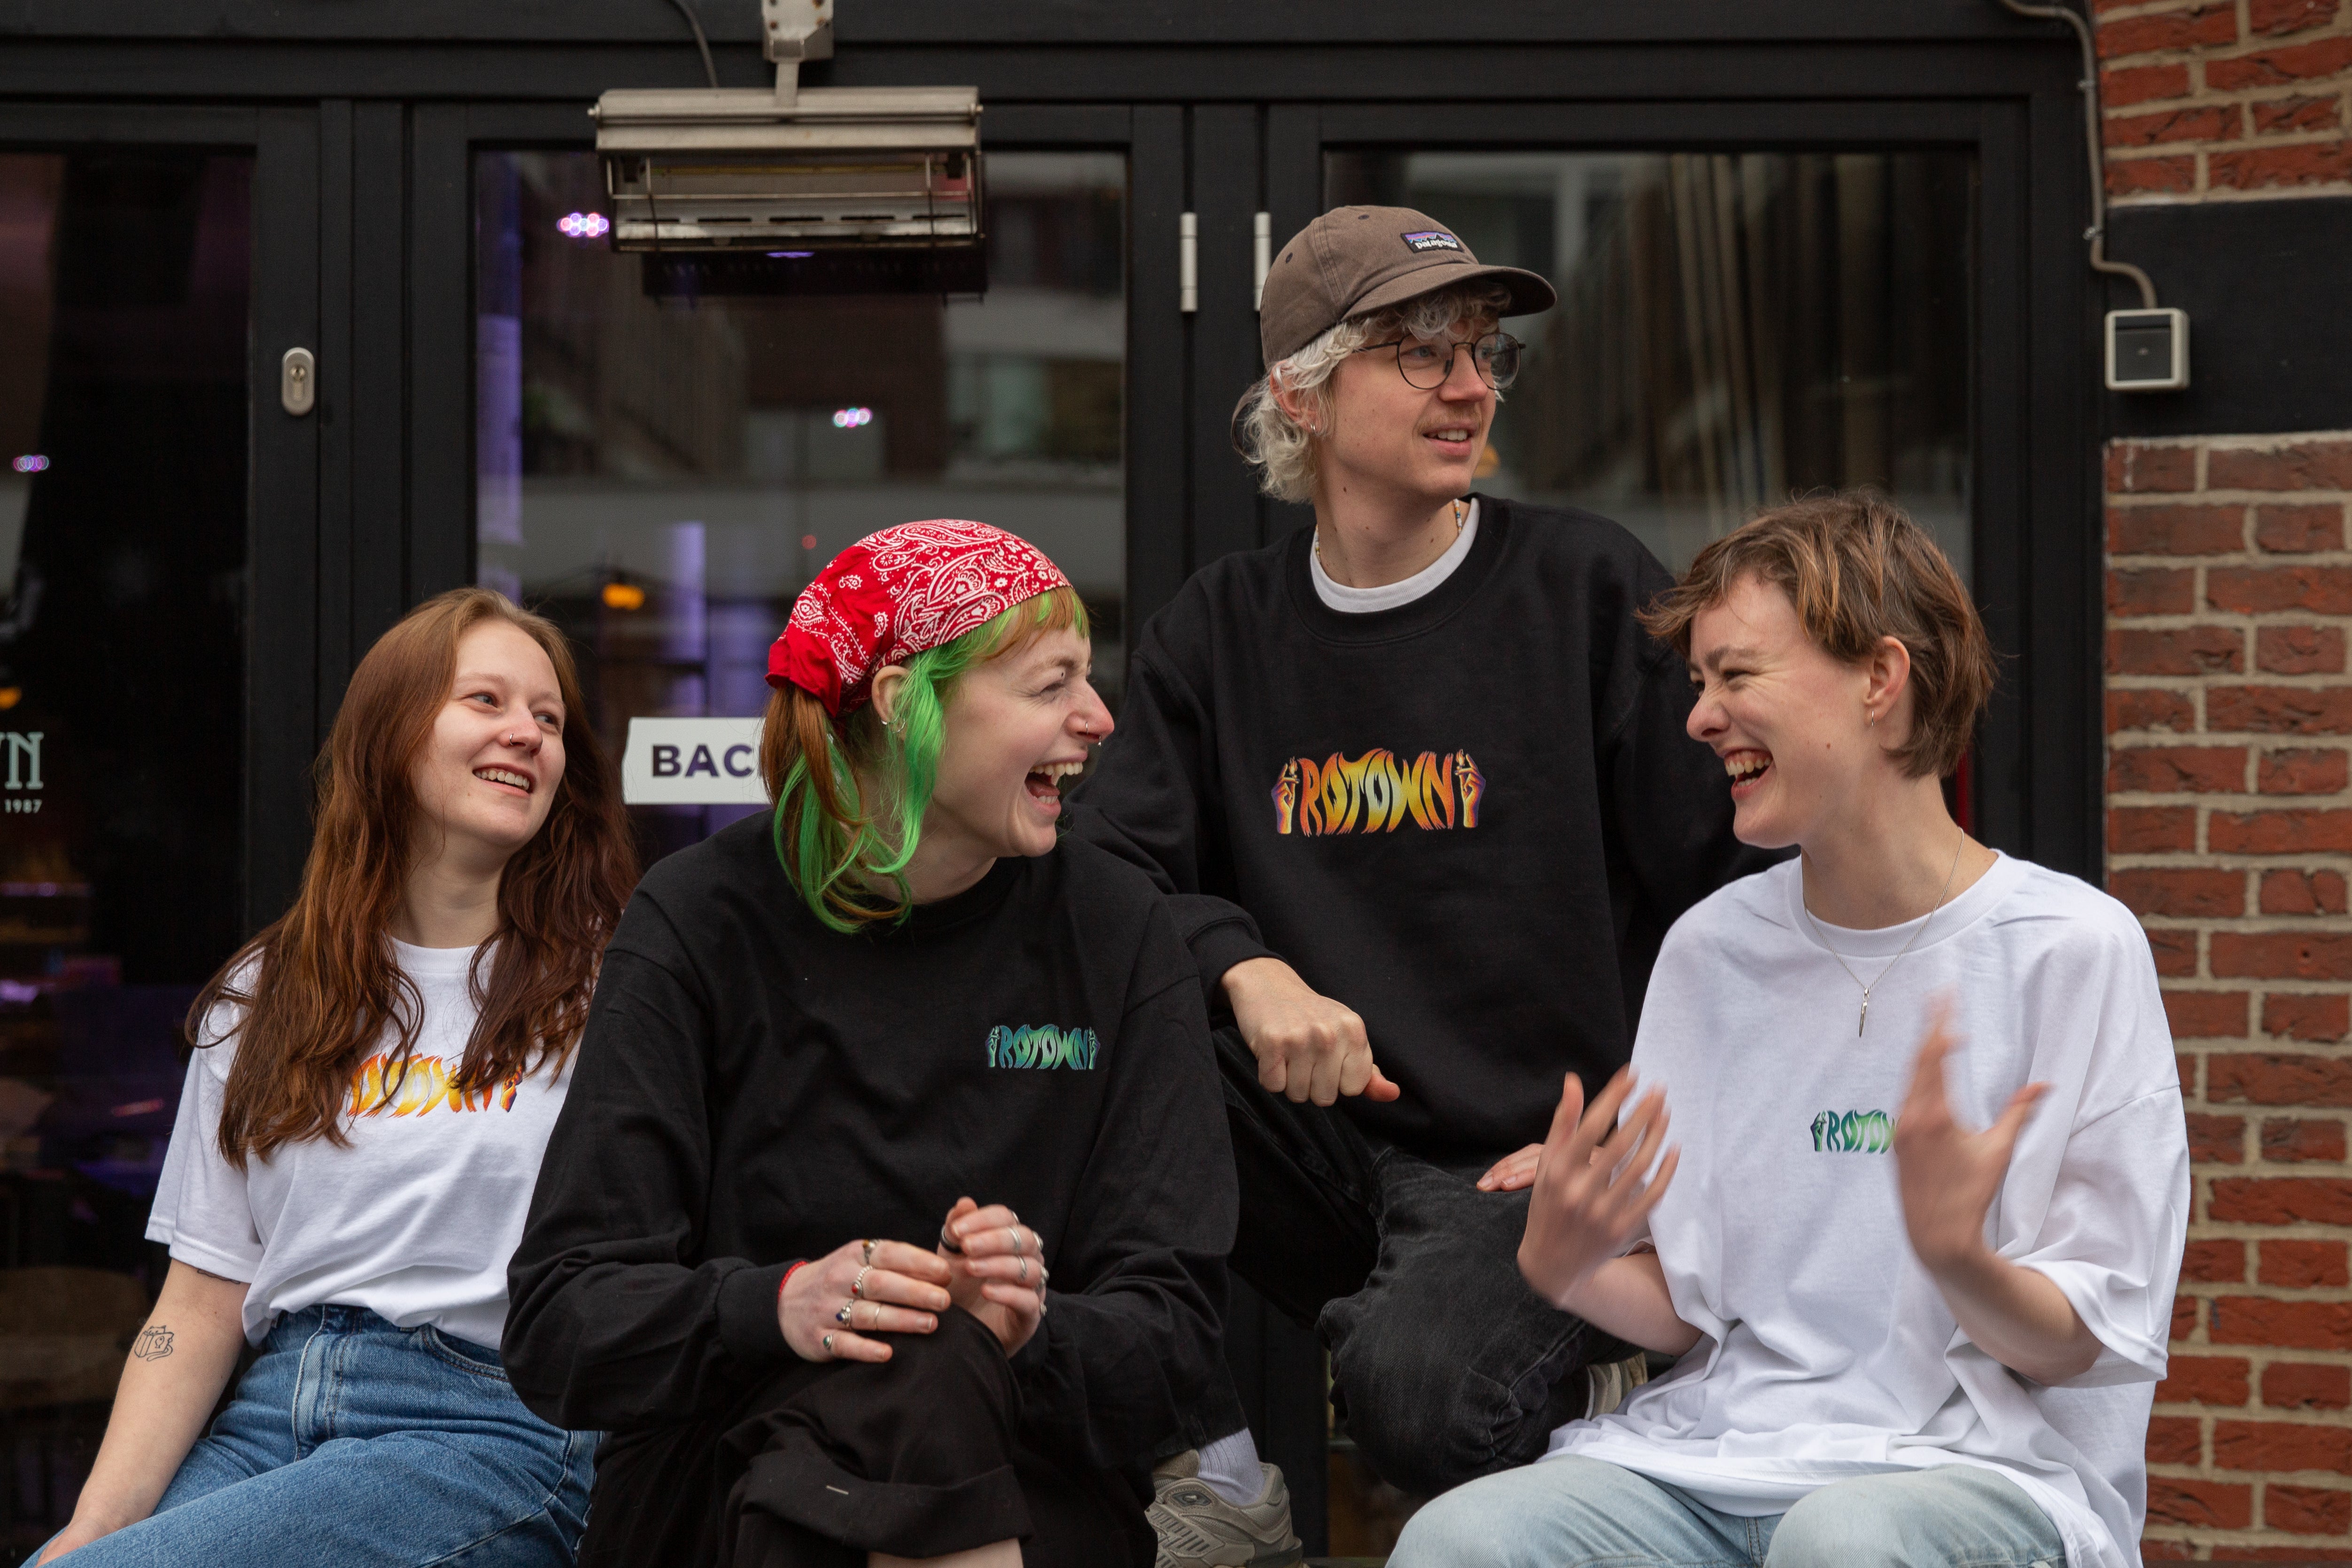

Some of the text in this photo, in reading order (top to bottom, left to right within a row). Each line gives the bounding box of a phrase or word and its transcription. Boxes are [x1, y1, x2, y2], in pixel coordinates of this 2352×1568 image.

[652, 745, 761, 777] BAC
[4, 799, 42, 814] 1987
[1297, 748, 1455, 837] ROTOWN
[999, 1024, 1088, 1070] ROTOWN
